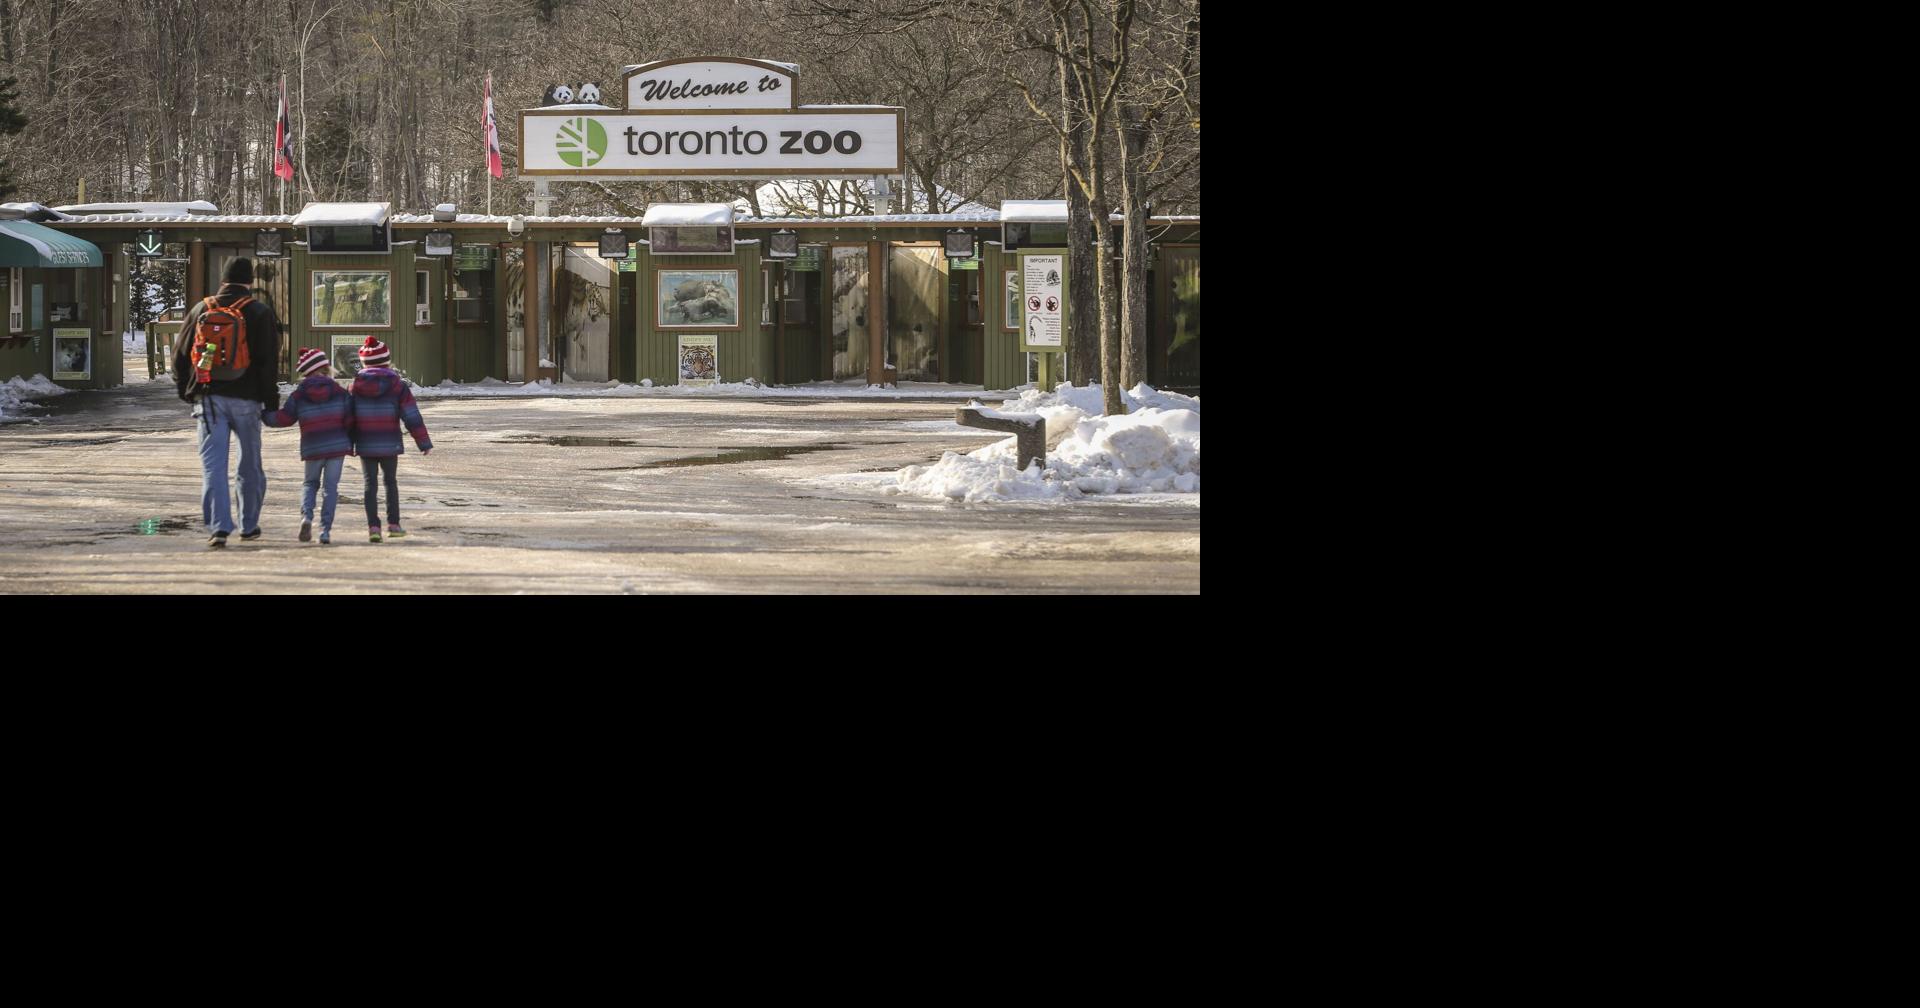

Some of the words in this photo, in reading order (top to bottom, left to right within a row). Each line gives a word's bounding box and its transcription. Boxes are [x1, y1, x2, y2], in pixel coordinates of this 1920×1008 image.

[640, 78, 749, 102] Welcome
[758, 75, 782, 93] to
[623, 125, 768, 156] toronto
[779, 130, 862, 155] zoo
